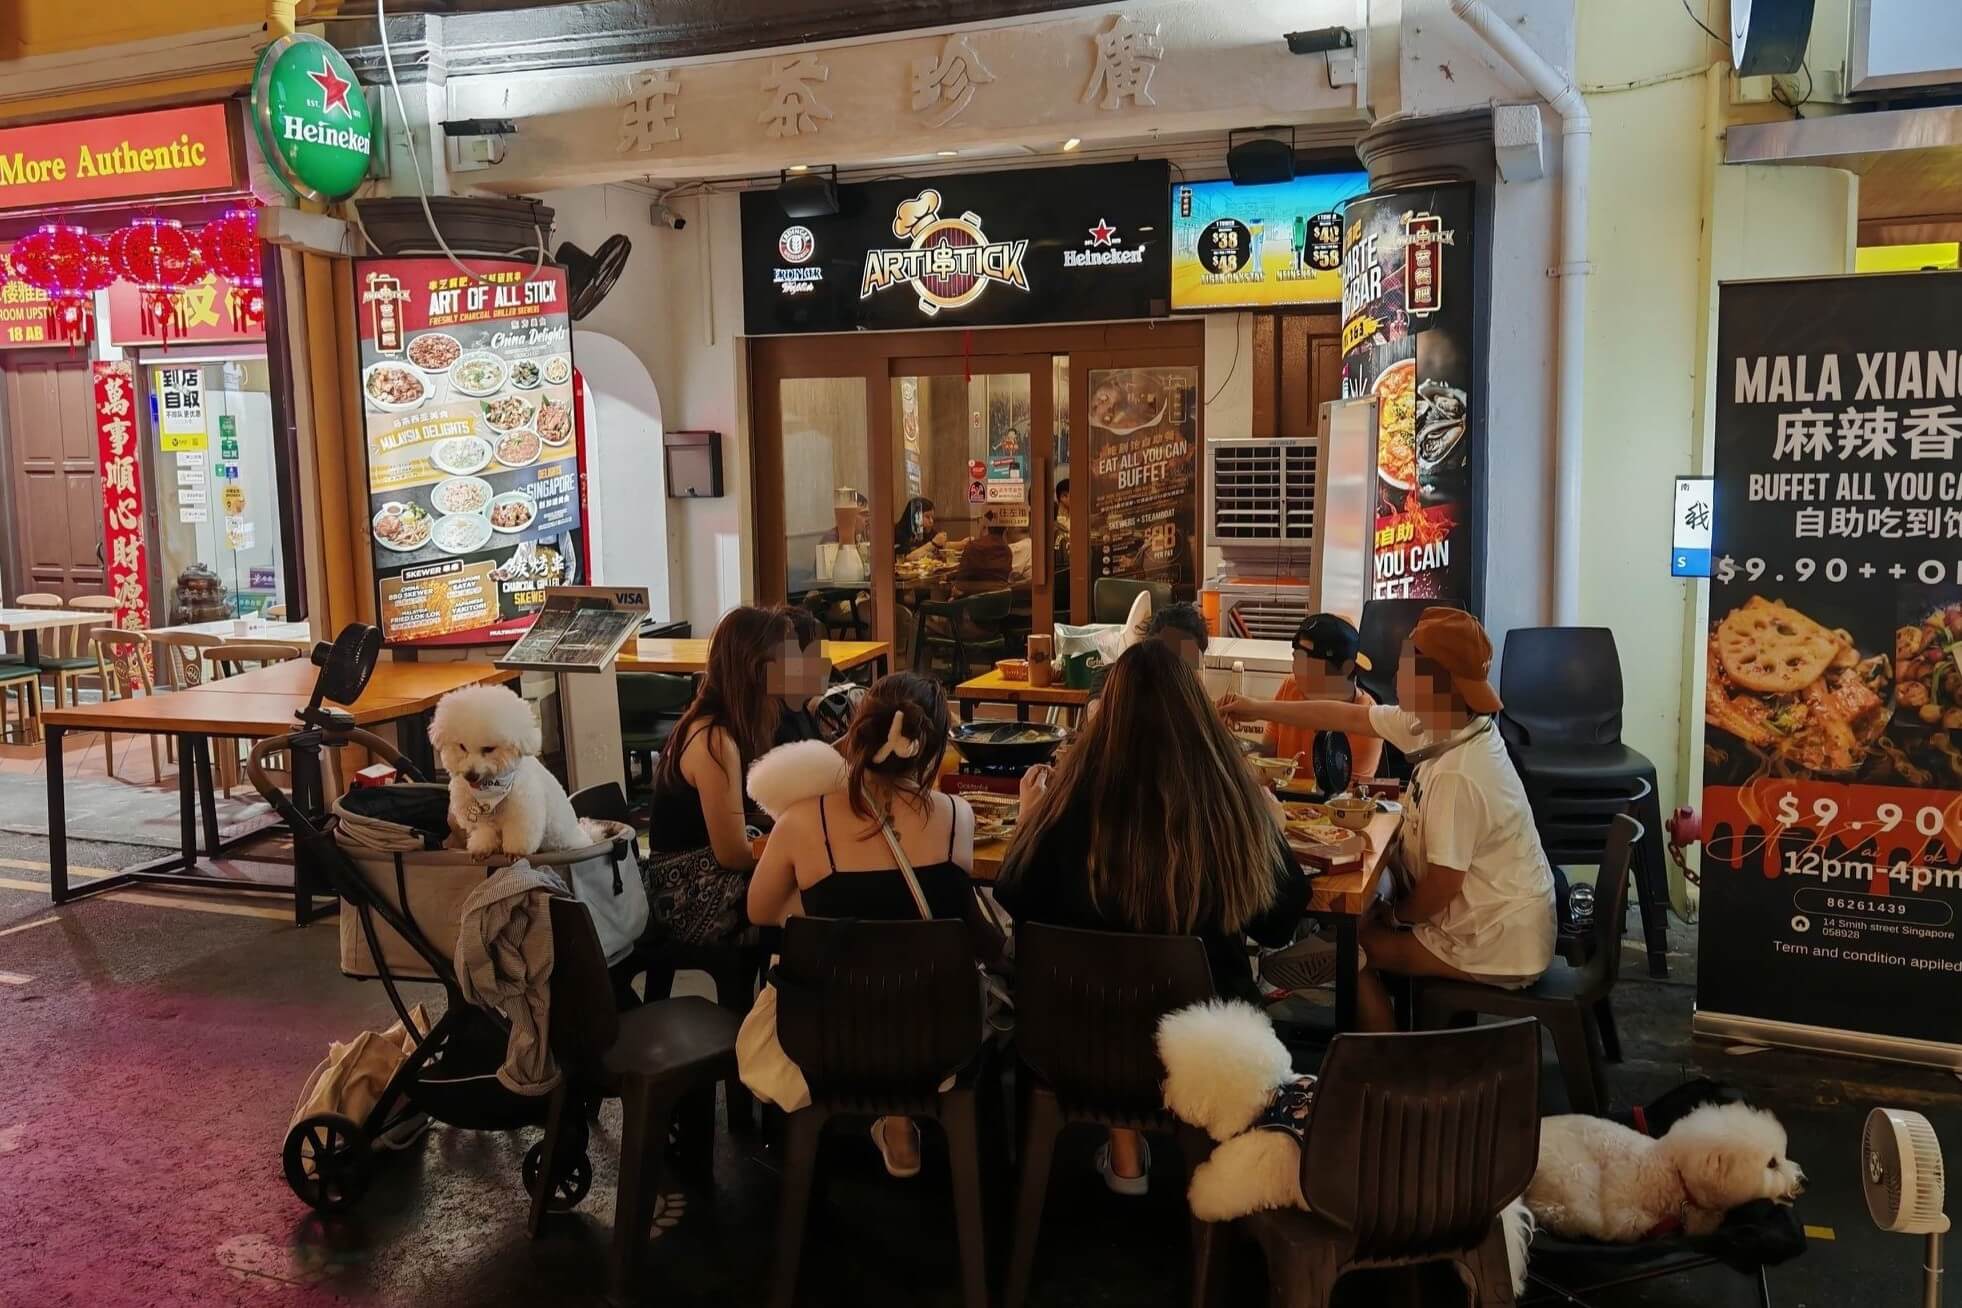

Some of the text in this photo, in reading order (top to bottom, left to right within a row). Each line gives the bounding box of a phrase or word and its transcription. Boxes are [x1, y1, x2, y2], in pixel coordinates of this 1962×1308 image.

[284, 115, 371, 155] Heineken
[0, 134, 207, 186] More Authentic
[1212, 232, 1238, 249] $38
[1063, 248, 1142, 267] Heineken
[1212, 255, 1237, 273] $48
[1313, 250, 1339, 267] $58
[429, 280, 557, 316] ART OF ALL STICK
[8, 326, 23, 341] 18
[491, 324, 566, 349] China Delights
[162, 369, 198, 387] 到店
[1735, 350, 1962, 404] MALA XIAN
[165, 391, 200, 409] 自取
[423, 421, 470, 439] DELIGHTS
[1773, 405, 1962, 461] 麻辣香
[1100, 457, 1118, 475] EAT
[1121, 453, 1139, 470] ALL
[1143, 446, 1163, 464] YOU
[1166, 440, 1187, 458] CAN
[1118, 461, 1168, 490] BUFFET
[527, 473, 575, 501] SINGAPORE
[1749, 473, 1830, 501] BUFFET
[1835, 473, 1875, 501] ALL
[1884, 472, 1933, 500] YOU
[1375, 522, 1414, 547] 自助
[1375, 540, 1449, 579] YOU CAN
[1677, 556, 1686, 567] S
[405, 565, 442, 579] SKEWER
[404, 588, 433, 599] SKEWER
[453, 581, 476, 590] SATAY
[514, 590, 545, 605] SKEWE
[615, 593, 644, 605] VISA
[452, 602, 487, 614] YAKITORI
[1776, 792, 1944, 836] $9.90
[1784, 851, 1962, 892] 12pm-4pm
[1827, 897, 1906, 915] 86261439
[1822, 928, 1860, 940] 058928
[1823, 918, 1954, 940] 14 Smith street Singapore
[1773, 940, 1808, 955] Term
[1812, 945, 1839, 958] and
[1842, 949, 1906, 966] condition
